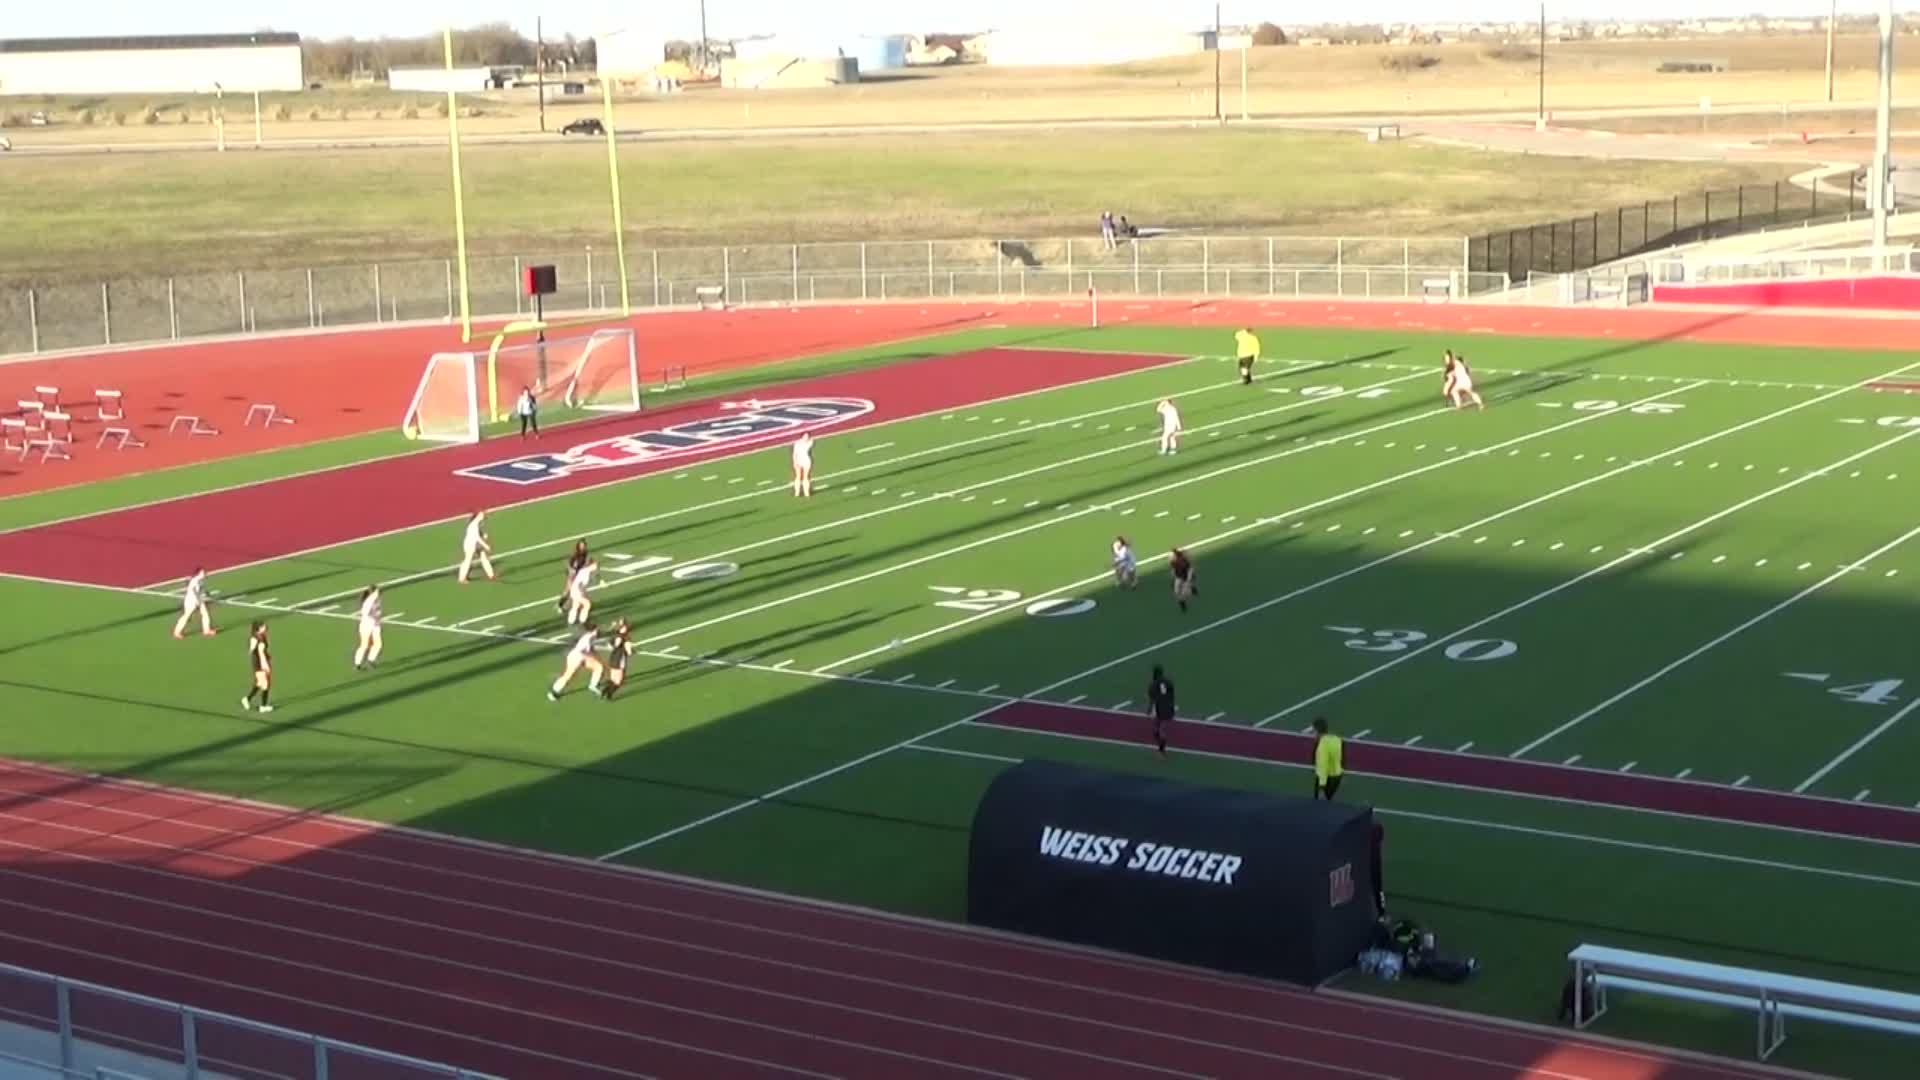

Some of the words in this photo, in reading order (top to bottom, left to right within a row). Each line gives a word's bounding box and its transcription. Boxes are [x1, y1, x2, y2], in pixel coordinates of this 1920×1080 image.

[601, 556, 740, 581] 10
[933, 588, 1098, 617] 20
[1344, 629, 1519, 661] 30
[1039, 825, 1129, 866] WEISS
[1127, 842, 1242, 885] SOCCER
